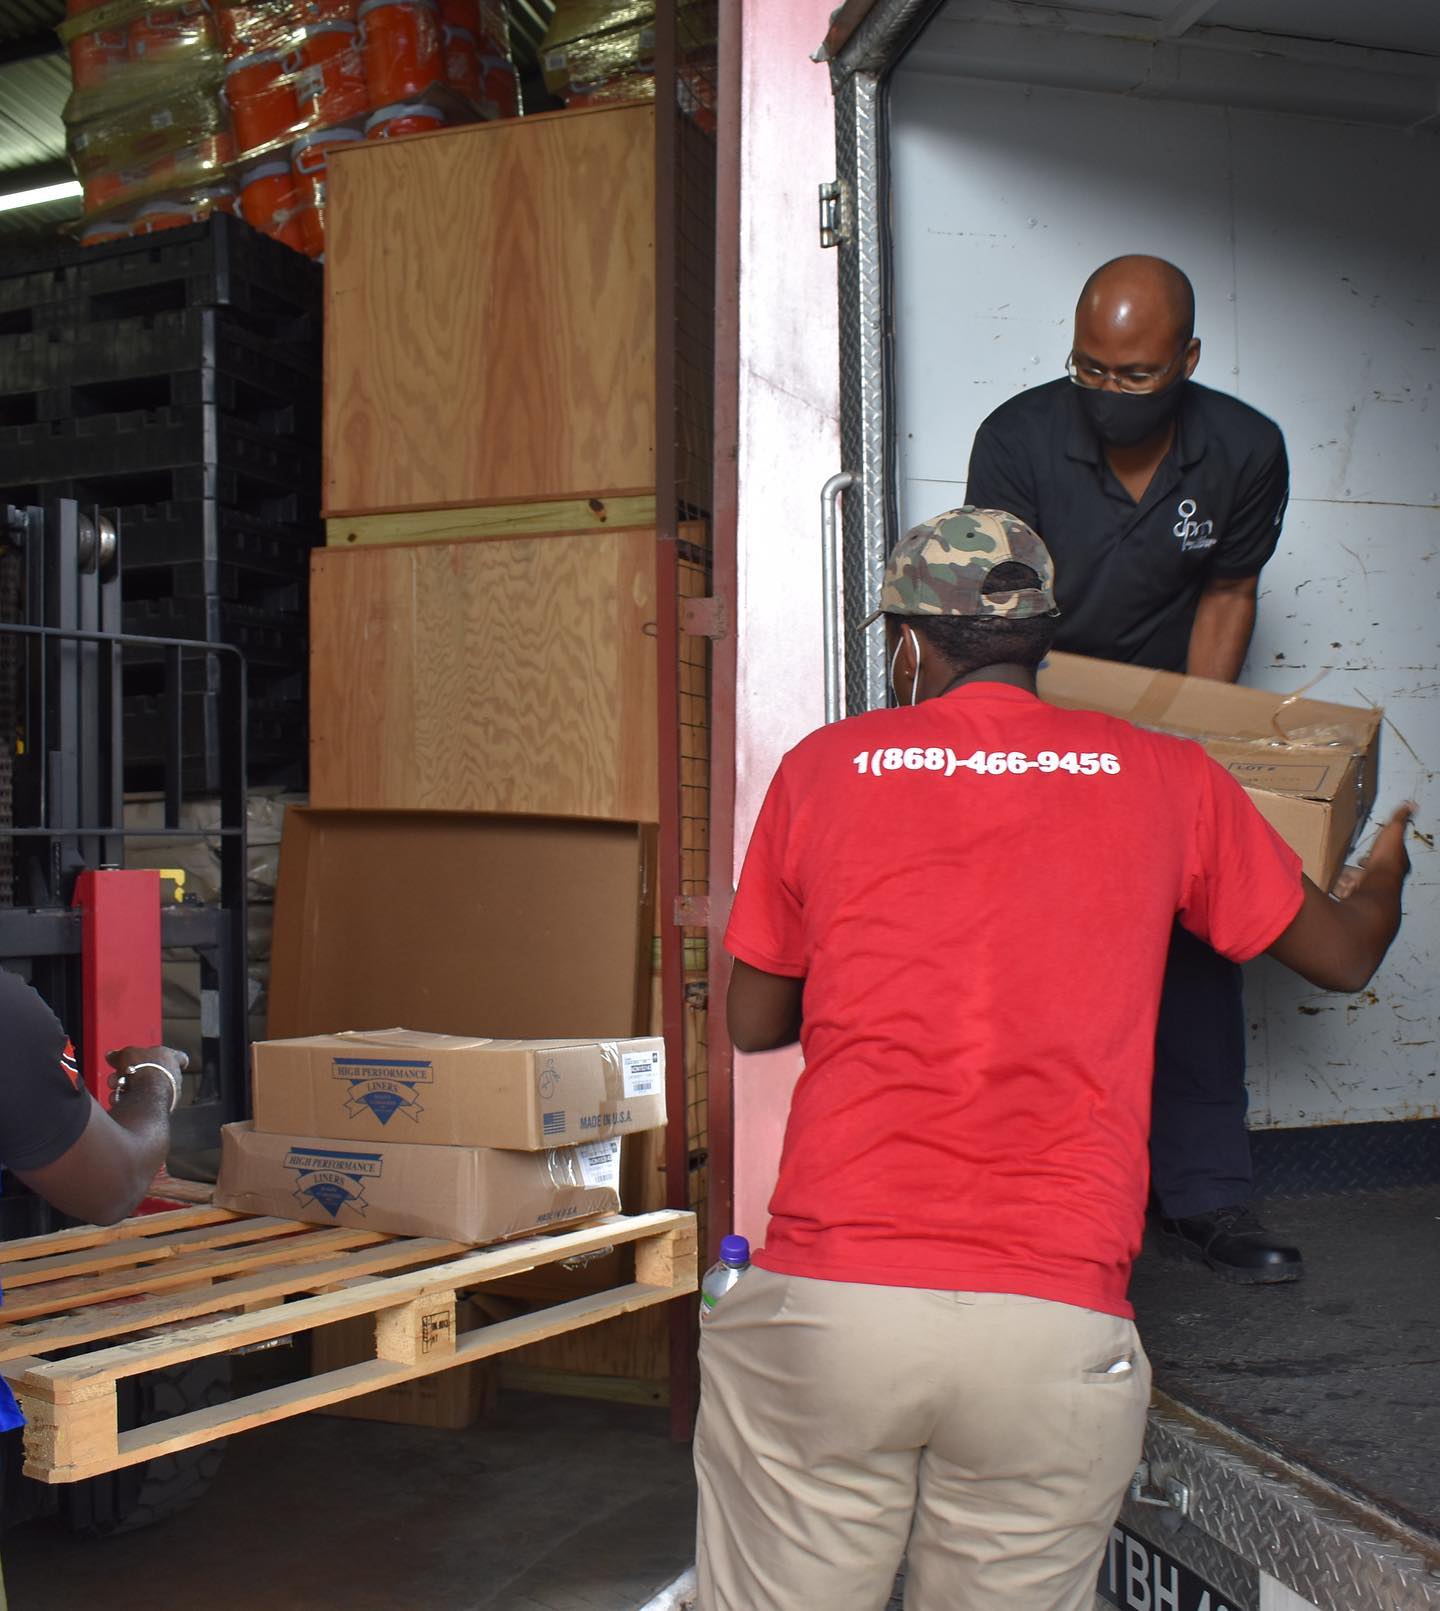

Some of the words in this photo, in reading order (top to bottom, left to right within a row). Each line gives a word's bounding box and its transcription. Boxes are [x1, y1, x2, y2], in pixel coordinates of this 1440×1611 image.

[853, 747, 1121, 776] 1(868)-466-9456
[337, 1066, 361, 1076] HIGH
[362, 1067, 428, 1079] PERFORMANCE
[367, 1081, 399, 1093] LINERS
[580, 1115, 602, 1129] MADE
[603, 1113, 612, 1126] IN
[289, 1156, 312, 1168] HIGH
[313, 1158, 376, 1173] PERFORMANCE
[313, 1173, 345, 1186] LINERS
[1109, 1526, 1179, 1611] TBH
